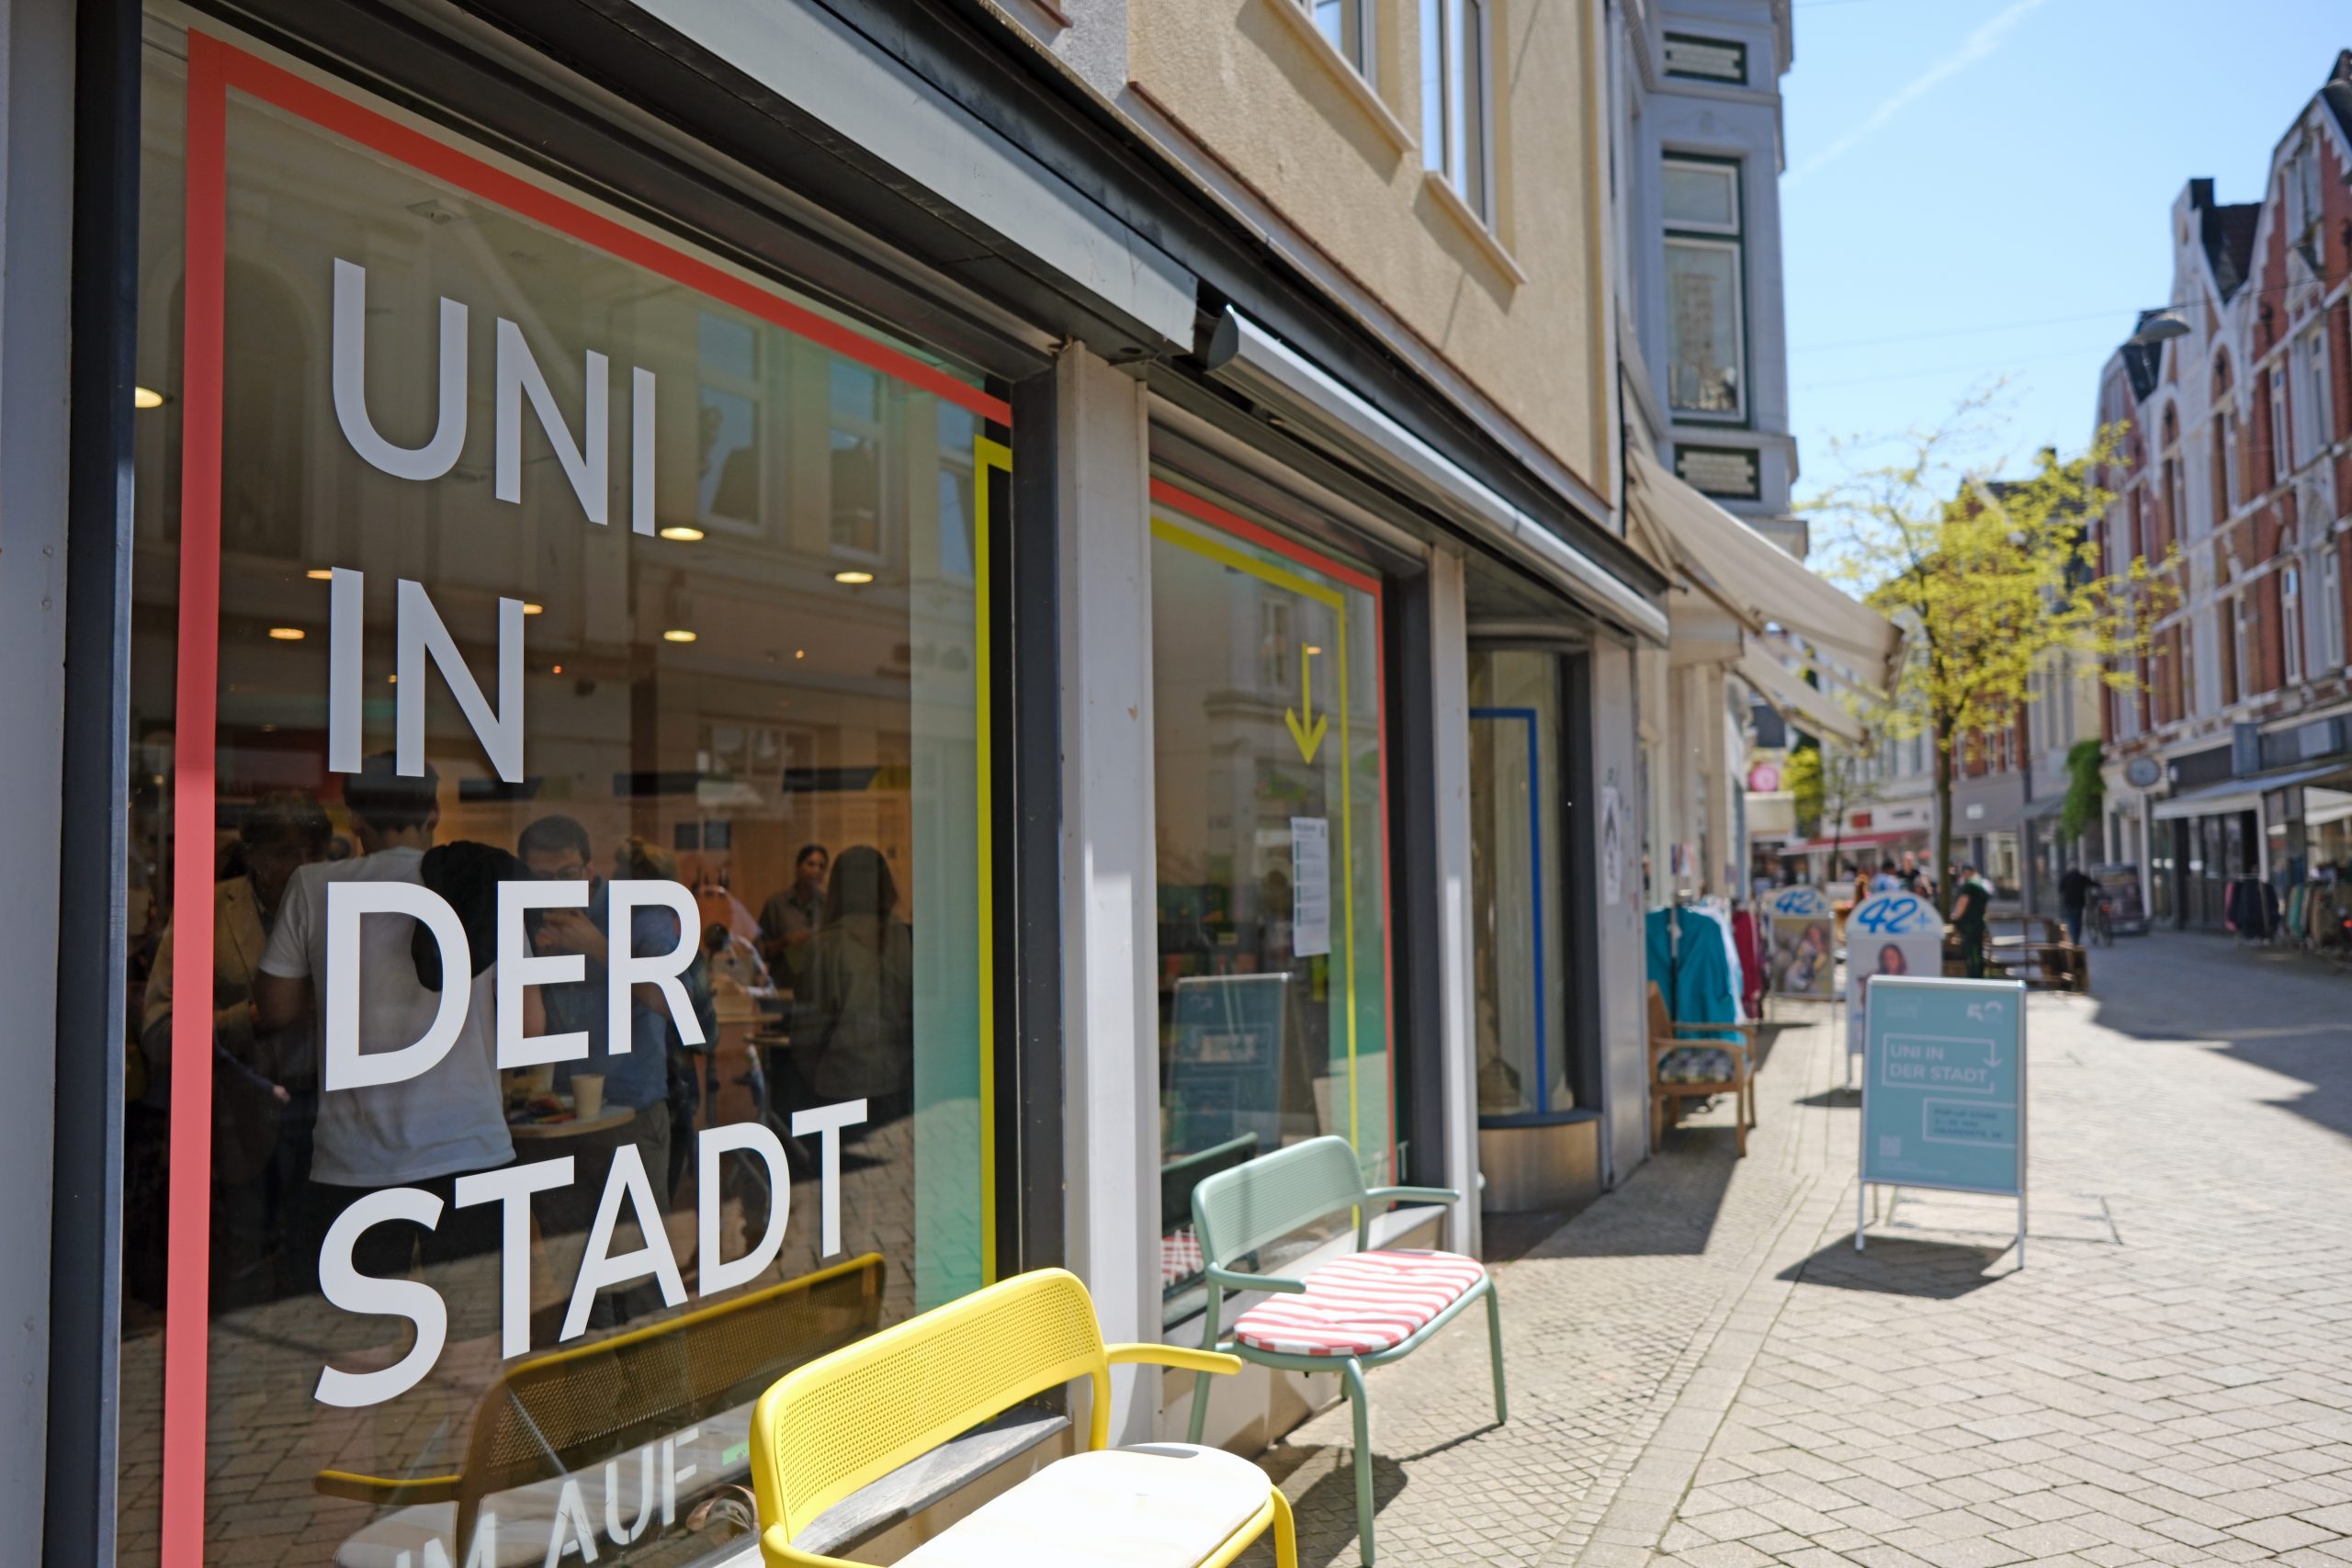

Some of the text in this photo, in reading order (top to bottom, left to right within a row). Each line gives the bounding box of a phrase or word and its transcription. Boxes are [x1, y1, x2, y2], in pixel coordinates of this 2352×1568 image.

[334, 257, 655, 536] UNI
[329, 566, 525, 784] IN
[325, 879, 707, 1091] DER
[1890, 1064, 1988, 1083] DER STADT
[1891, 1044, 1944, 1061] UNI IN
[313, 1098, 868, 1407] STADT
[544, 1427, 699, 1568] AUF
